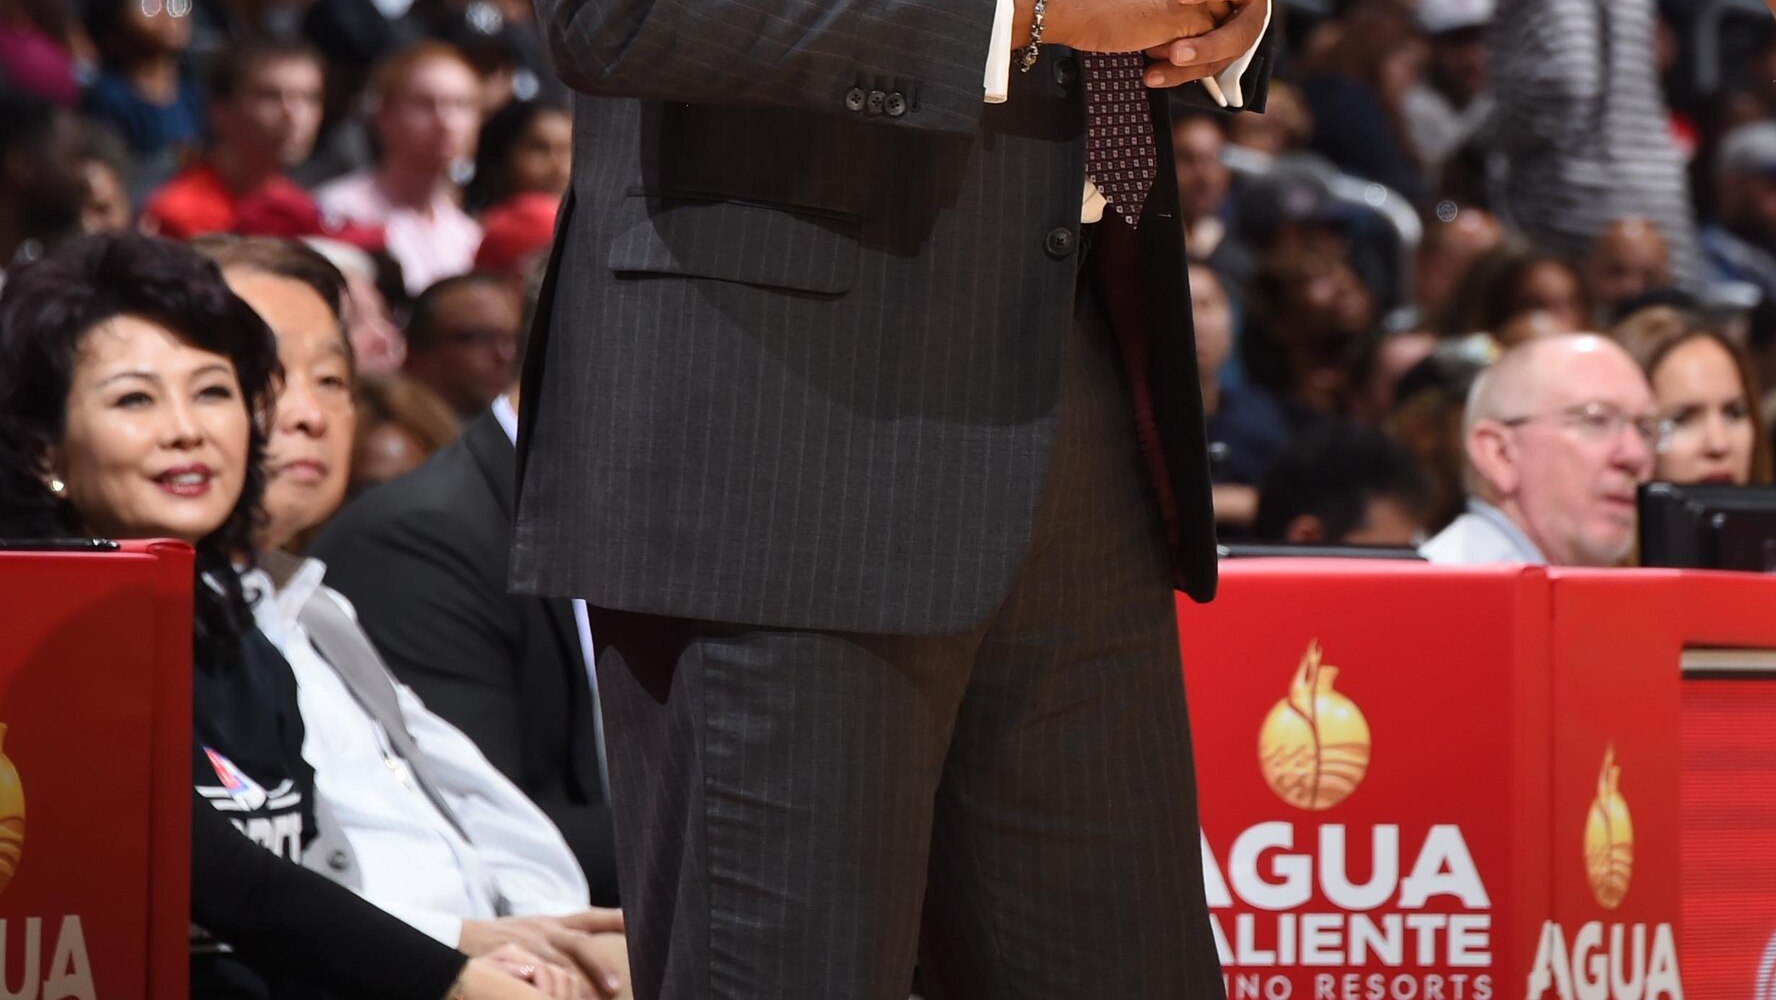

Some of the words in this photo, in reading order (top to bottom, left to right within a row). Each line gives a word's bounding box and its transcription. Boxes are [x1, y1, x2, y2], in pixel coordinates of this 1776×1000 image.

[0, 913, 99, 1000] UA
[1208, 912, 1492, 967] LIENTE
[1525, 919, 1687, 1000] AGUA
[1314, 973, 1493, 1000] RESORTS
